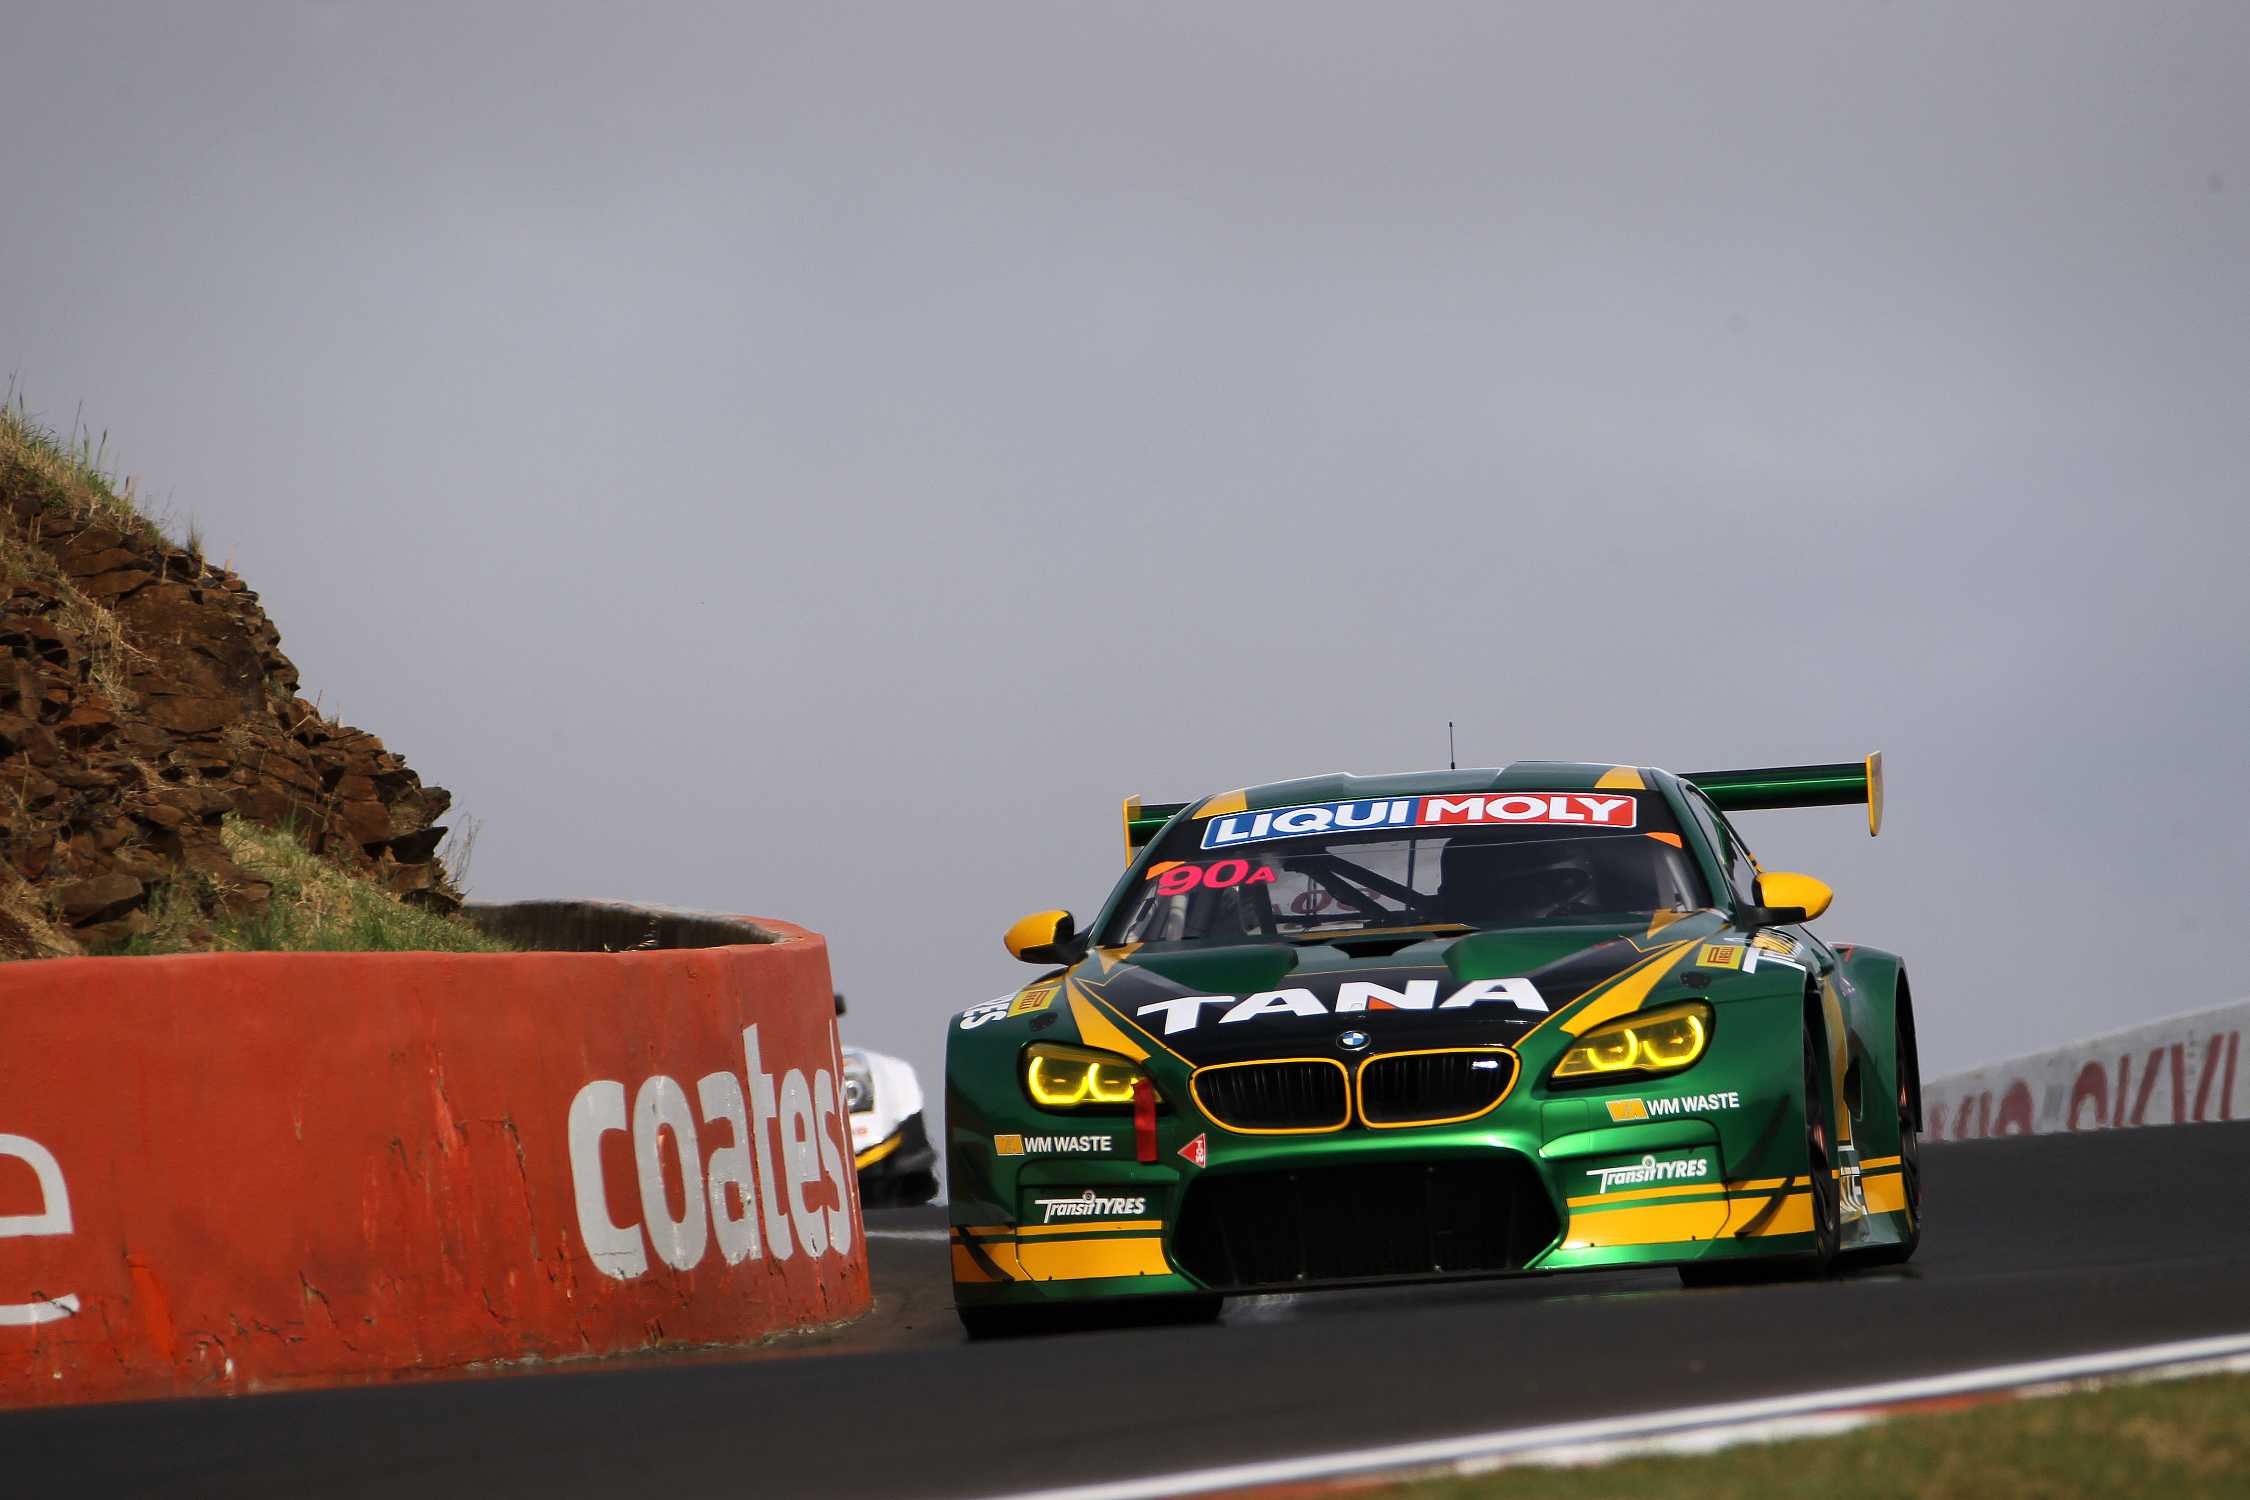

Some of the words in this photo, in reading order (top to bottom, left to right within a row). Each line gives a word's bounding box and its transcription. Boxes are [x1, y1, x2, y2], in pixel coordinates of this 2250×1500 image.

[1215, 800, 1411, 843] LIQUI
[1424, 796, 1629, 822] MOLY
[1136, 978, 1551, 1035] TANA
[1647, 1098, 1680, 1116] WM
[1681, 1092, 1740, 1113] WASTE
[568, 1023, 852, 1280] coates
[1024, 1136, 1052, 1153] WM
[1054, 1135, 1113, 1153] WASTE
